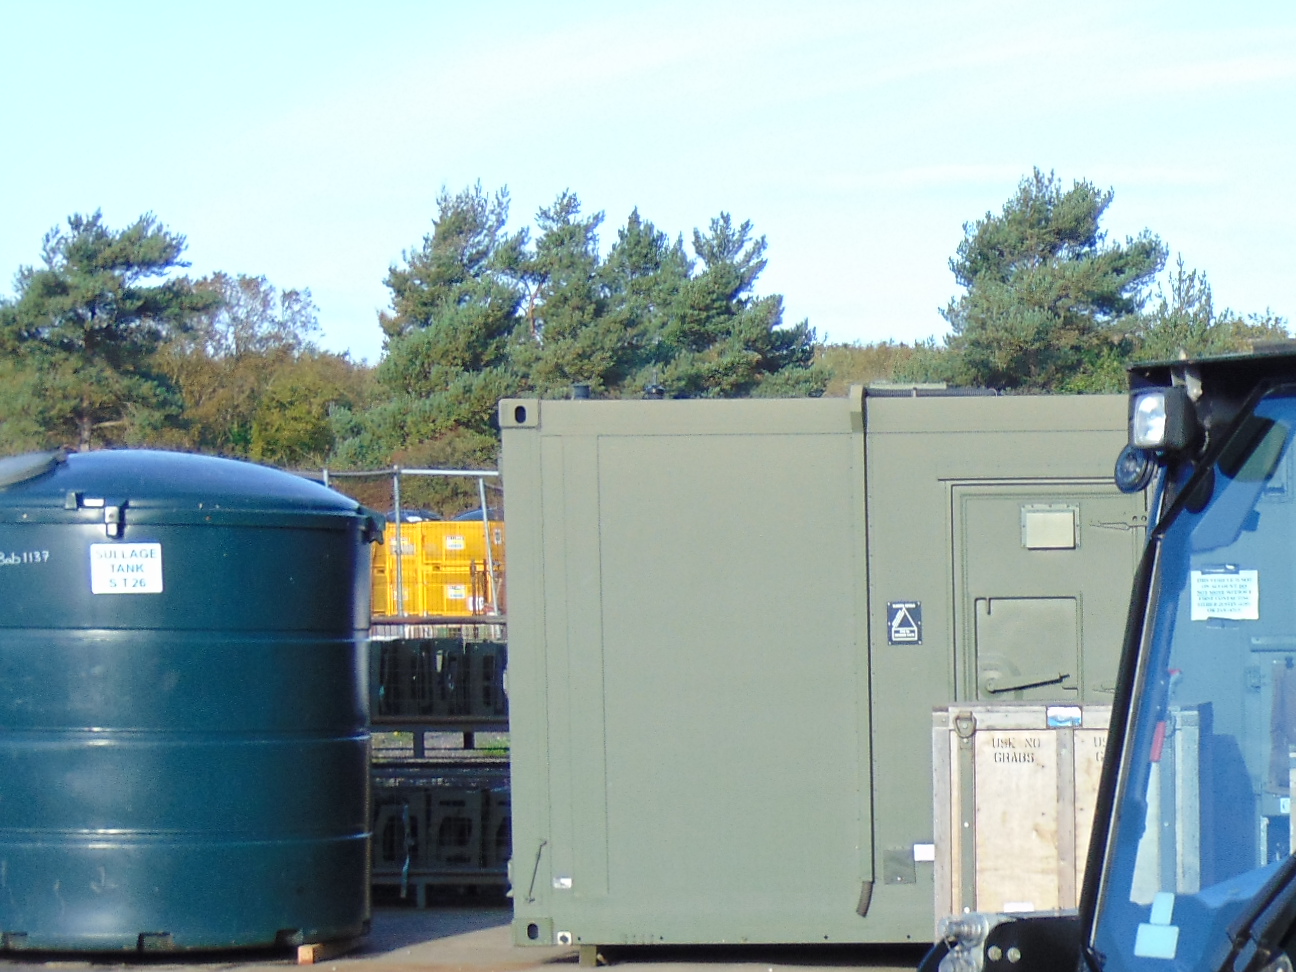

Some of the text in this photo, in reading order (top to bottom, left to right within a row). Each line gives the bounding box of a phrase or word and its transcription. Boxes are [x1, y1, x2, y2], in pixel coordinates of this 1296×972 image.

[95, 548, 157, 559] SULLAGE
[111, 563, 144, 573] TANK
[994, 752, 1035, 763] GRABS
